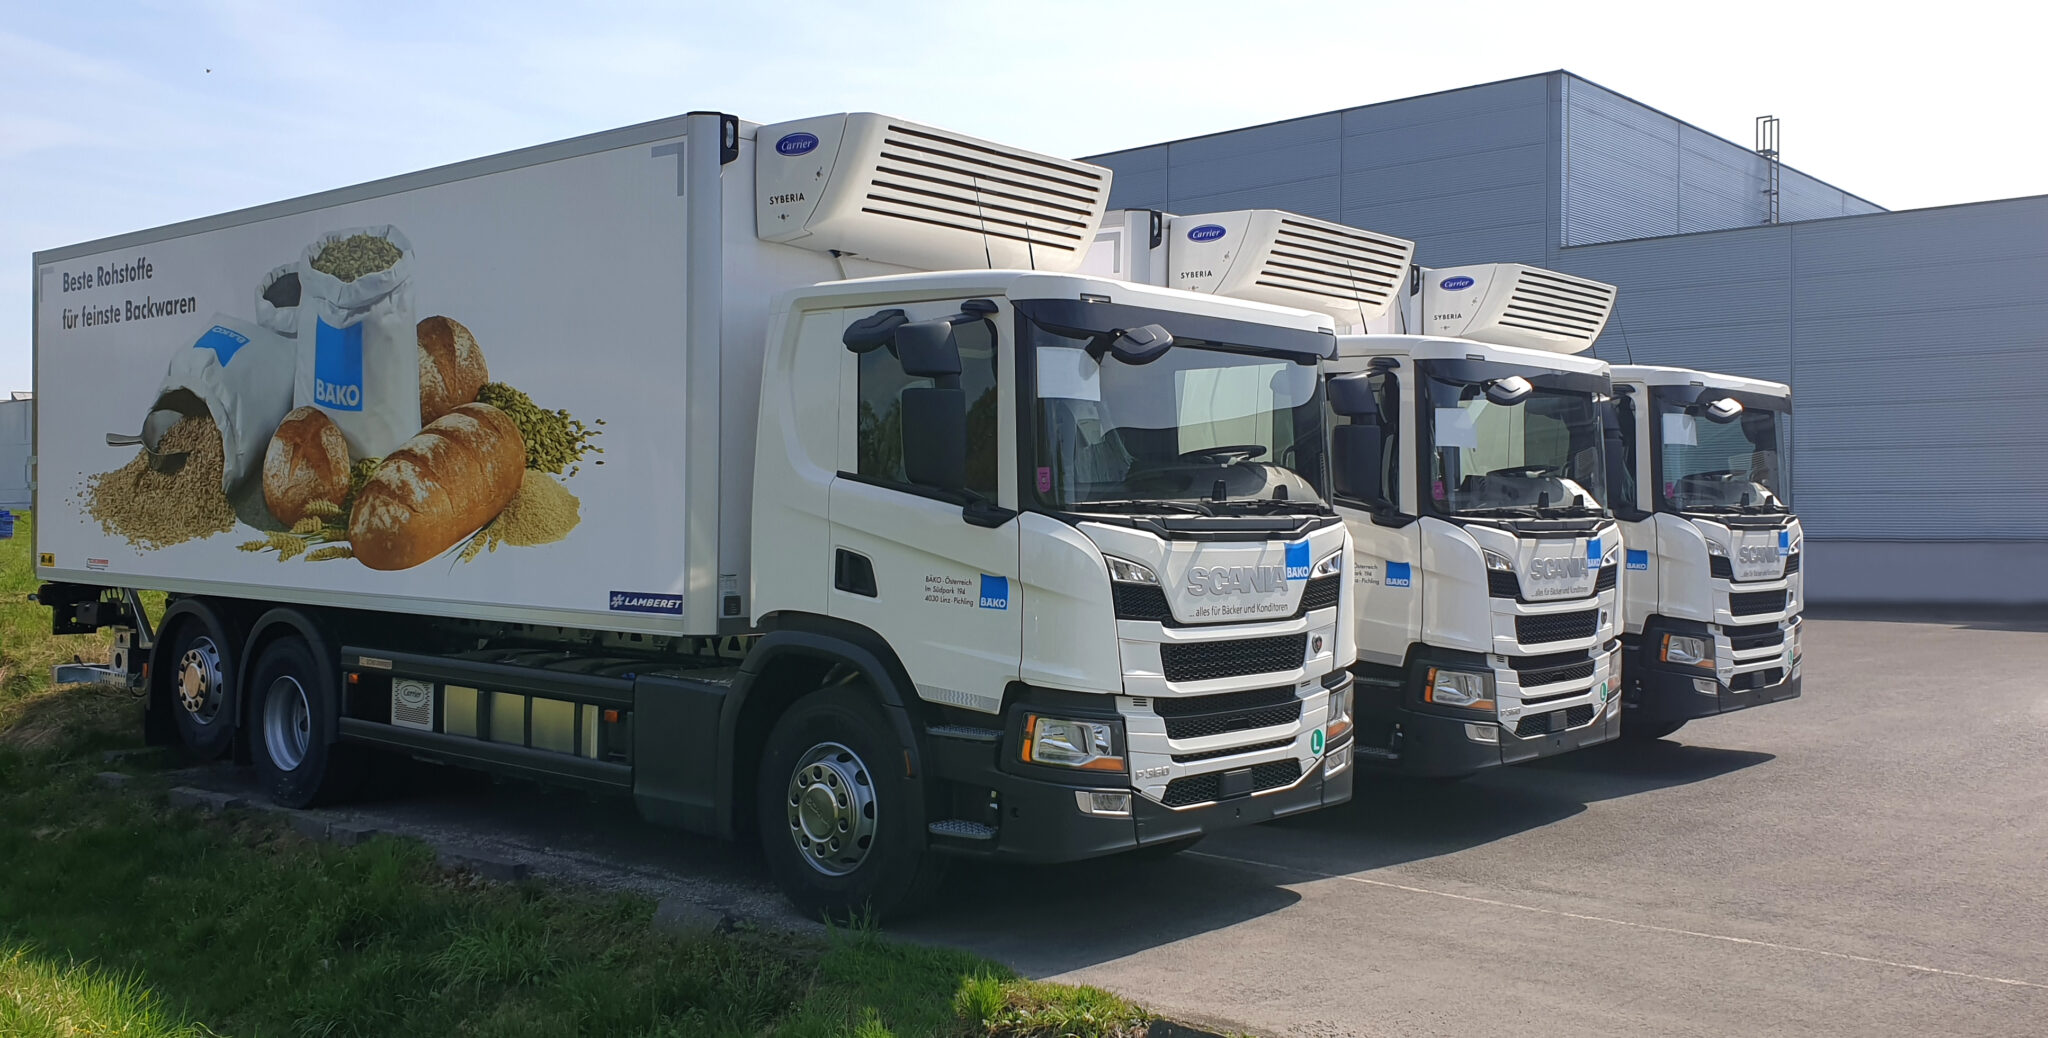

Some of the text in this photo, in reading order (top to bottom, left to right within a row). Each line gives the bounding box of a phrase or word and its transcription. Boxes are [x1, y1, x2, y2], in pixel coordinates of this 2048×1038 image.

[781, 140, 812, 151] Carrier
[769, 192, 805, 205] SYBERIA
[1192, 229, 1220, 239] Carrier
[62, 256, 153, 293] Beste Rohstoffe
[1180, 270, 1212, 279] SYBERIA
[1444, 280, 1470, 288] Carrier
[62, 295, 196, 330] für feinste Backwaren
[1433, 313, 1462, 321] SYBERIA
[316, 378, 360, 407] BÄKO
[1287, 566, 1310, 578] BÄKO
[1531, 557, 1589, 581] SCANIA
[1187, 566, 1289, 597] SCANIA
[933, 585, 954, 595] Südpark
[624, 597, 682, 609] LAMBERET
[980, 597, 1006, 608] BÄKO
[1211, 605, 1220, 616] für
[1222, 604, 1242, 615] Bäcker
[1243, 604, 1255, 614] und
[1256, 603, 1288, 613] Konditoren
